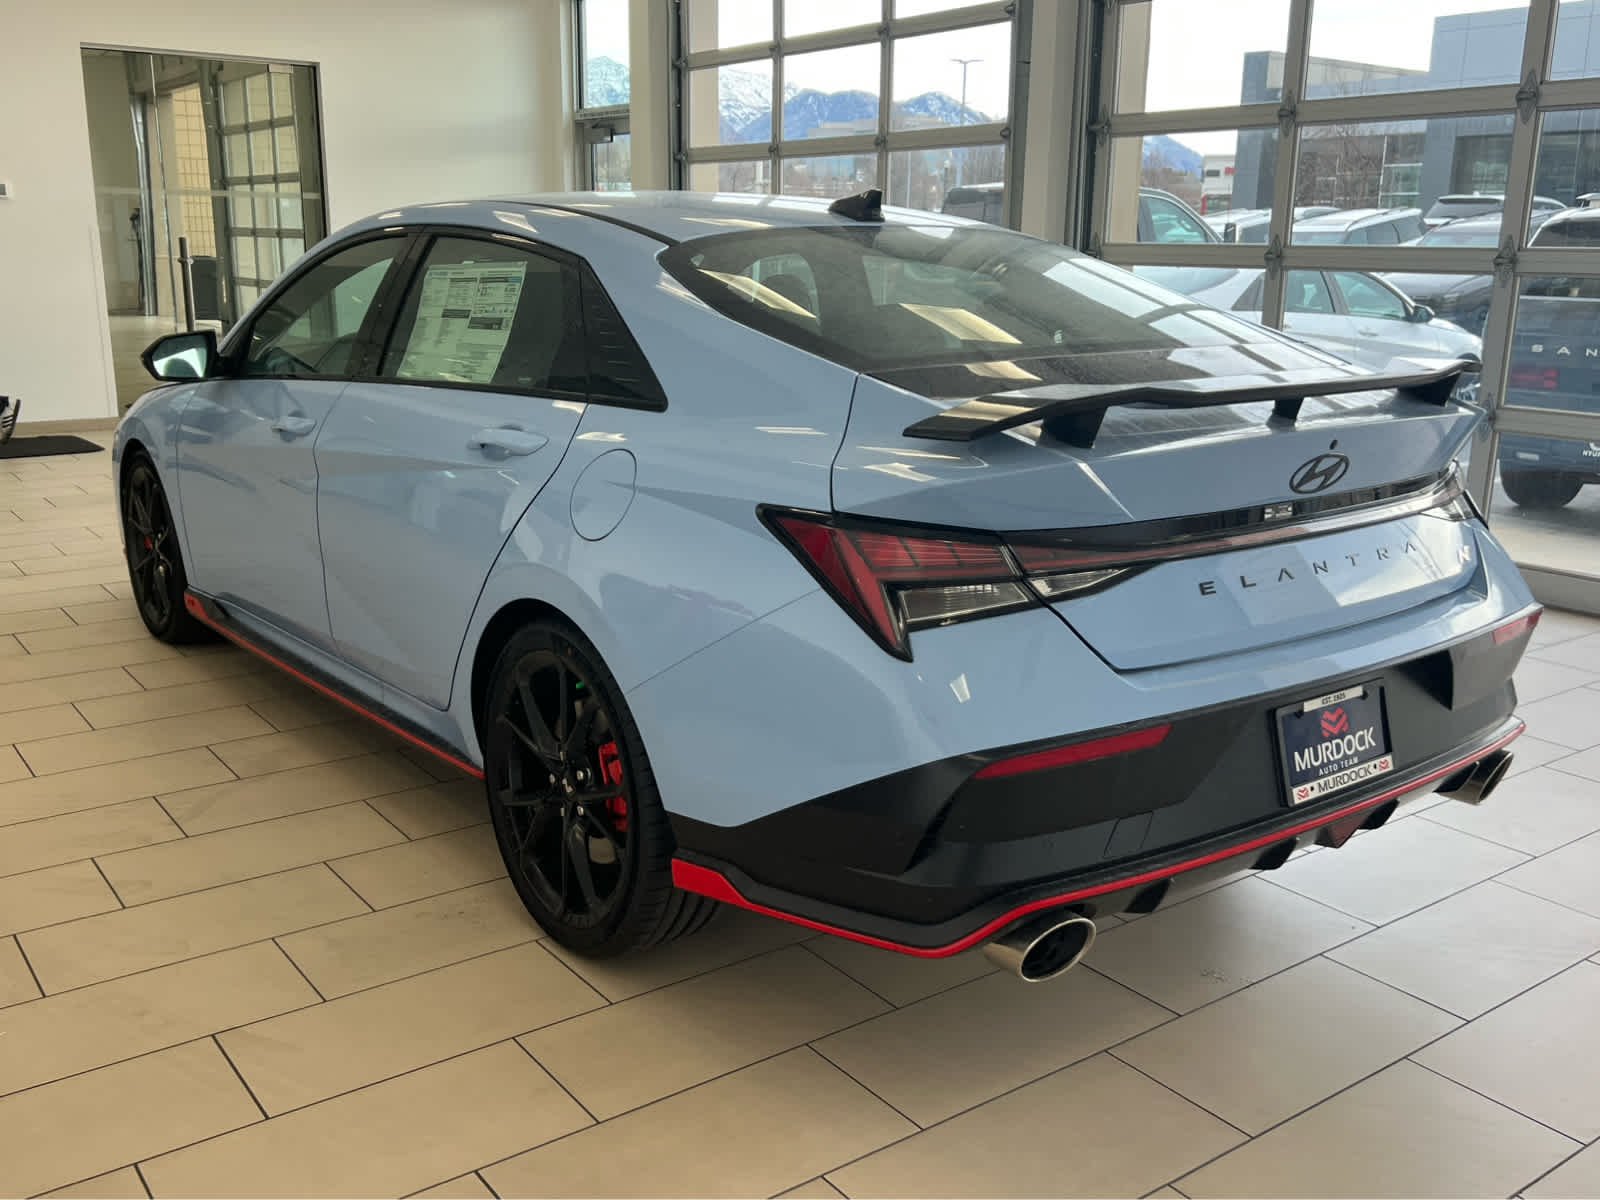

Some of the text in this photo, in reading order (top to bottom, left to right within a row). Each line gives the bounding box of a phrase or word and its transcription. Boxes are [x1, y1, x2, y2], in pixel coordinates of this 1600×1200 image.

[1531, 344, 1598, 358] SAN
[1198, 541, 1417, 596] ELANTRA
[1293, 726, 1376, 772] MURDOCK
[1317, 764, 1373, 793] MURDOCK
[1318, 756, 1359, 776] AUTO TEAM
